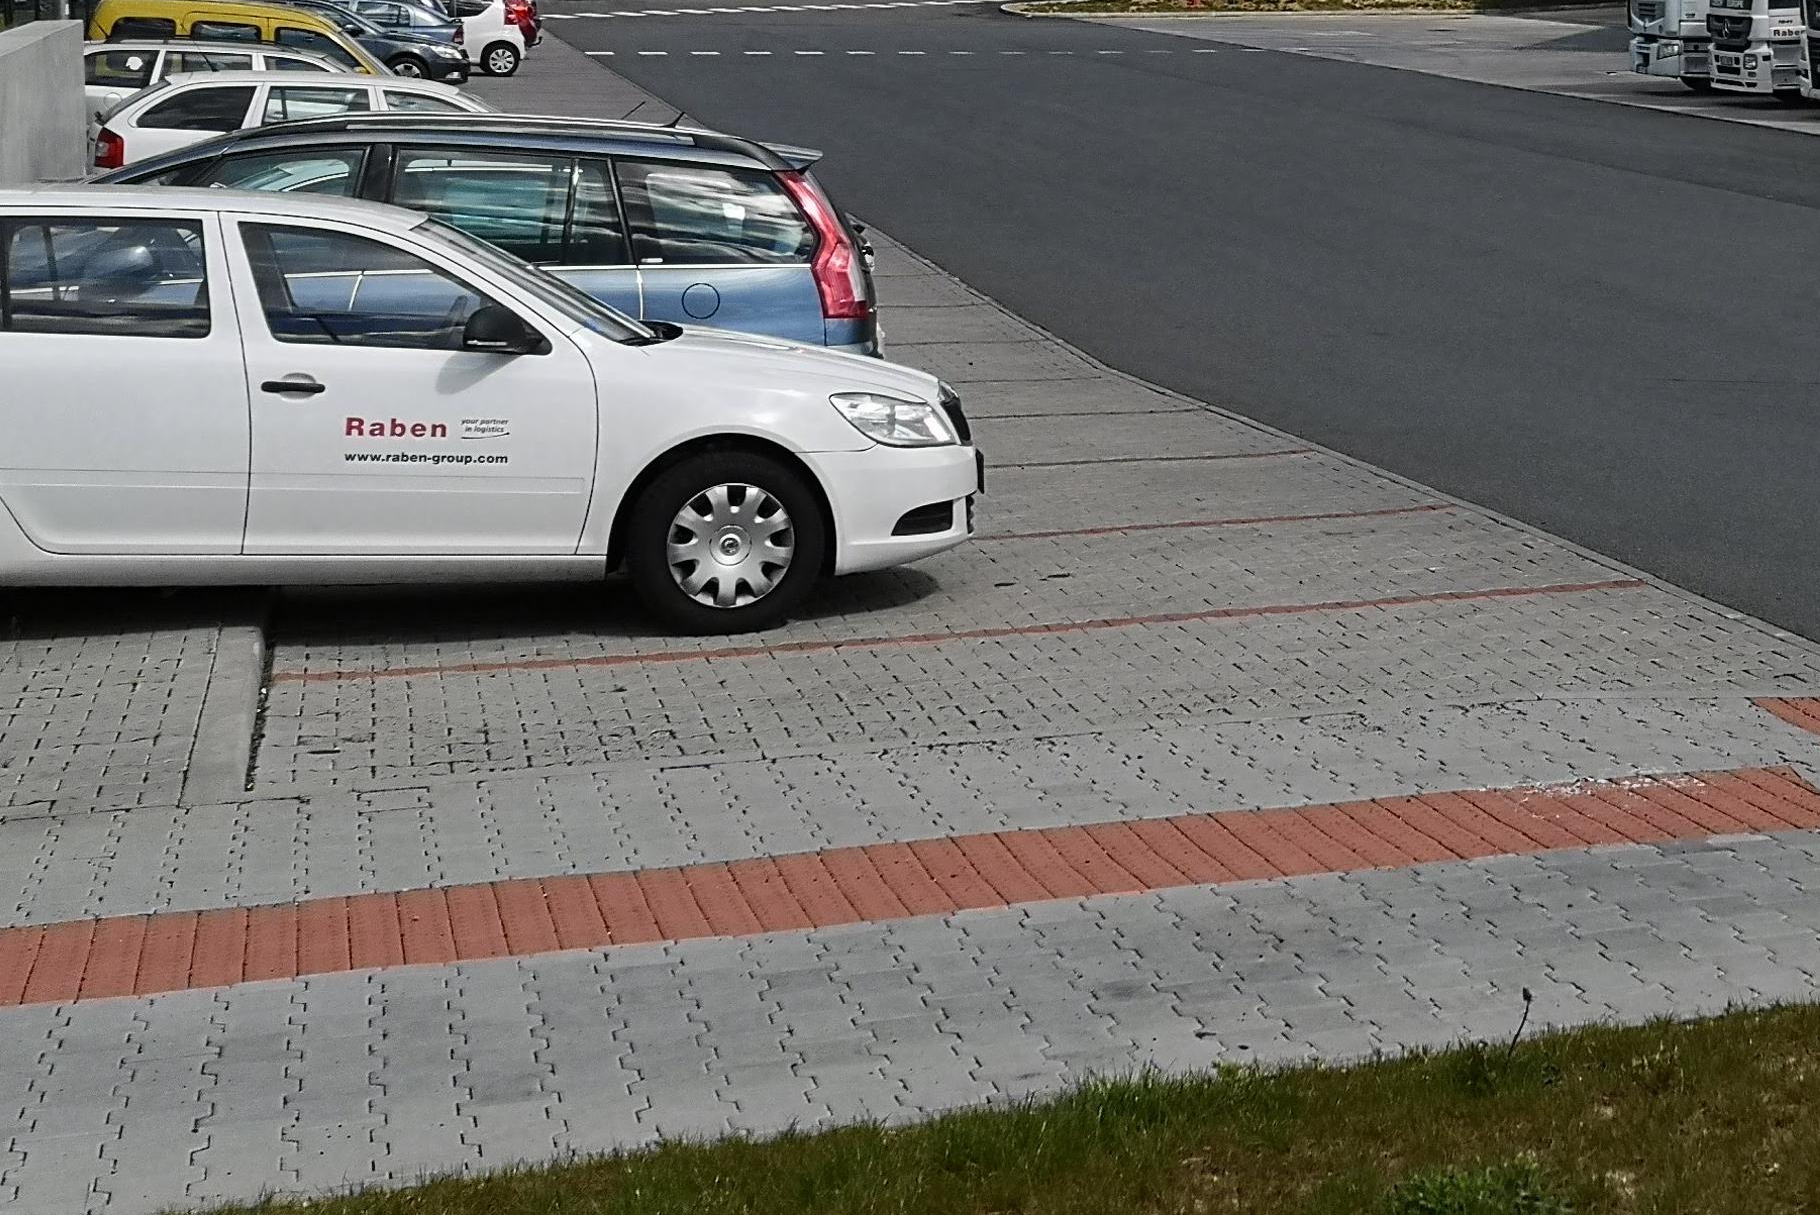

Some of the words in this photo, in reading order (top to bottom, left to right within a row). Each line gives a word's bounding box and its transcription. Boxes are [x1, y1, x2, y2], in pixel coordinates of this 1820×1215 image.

[345, 417, 447, 438] Raben
[479, 418, 509, 426] partner
[344, 452, 508, 465] www.raben-group.com
